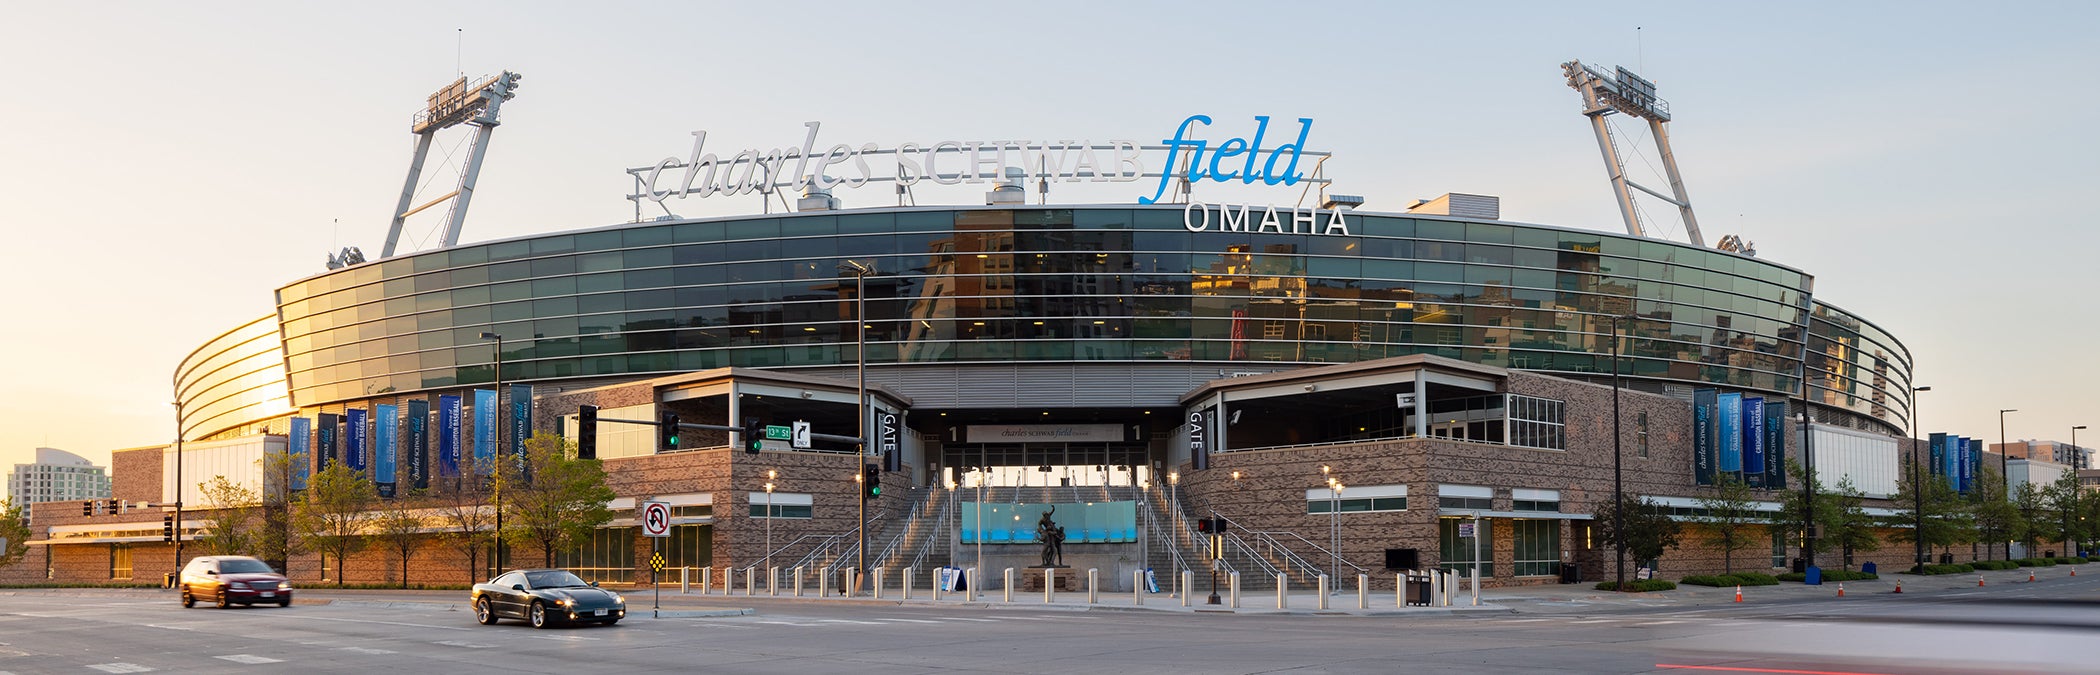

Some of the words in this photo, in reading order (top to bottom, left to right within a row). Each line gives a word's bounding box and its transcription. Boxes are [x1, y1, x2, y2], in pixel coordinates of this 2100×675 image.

[645, 121, 879, 202] charles
[895, 139, 1144, 186] SCHWAB
[1138, 114, 1313, 205] field
[1184, 201, 1349, 236] OMAHA
[515, 402, 525, 422] field
[1698, 406, 1708, 423] field
[413, 417, 422, 434] field
[884, 414, 896, 450] GATE
[949, 426, 957, 441] 1
[1001, 428, 1028, 437] charles
[1054, 428, 1072, 438] field
[1133, 425, 1140, 440] 1
[1190, 412, 1202, 449] GATE
[1768, 417, 1777, 432] field
[412, 457, 421, 480] charles
